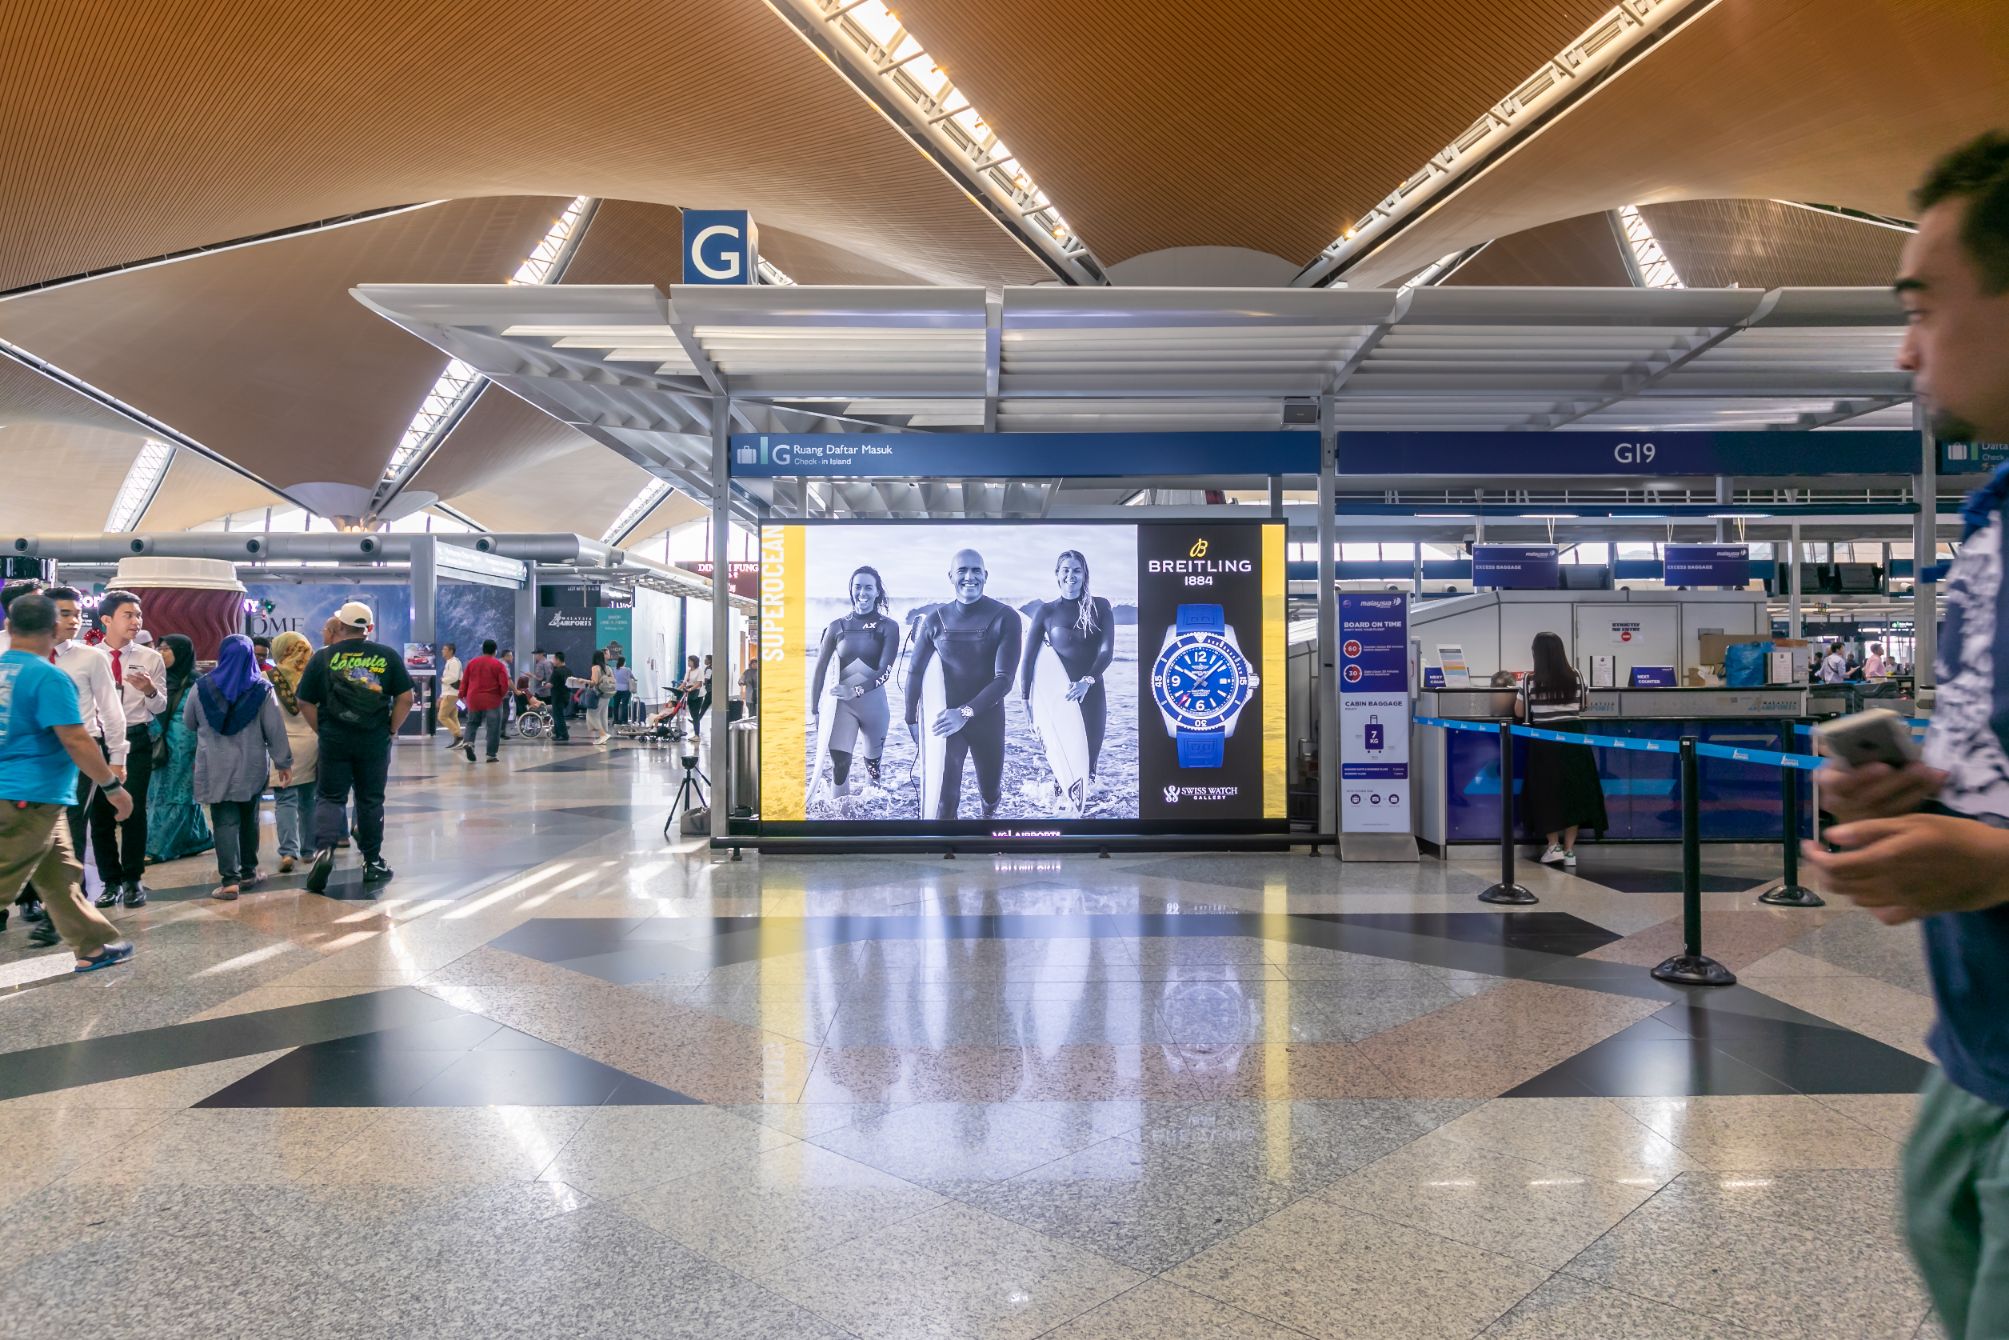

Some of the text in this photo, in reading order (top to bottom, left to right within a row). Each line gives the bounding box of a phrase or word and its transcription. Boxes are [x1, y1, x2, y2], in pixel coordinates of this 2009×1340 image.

[691, 225, 740, 279] G
[772, 444, 791, 465] G
[793, 445, 892, 456] Ruang Daftar Masuk
[1614, 443, 1656, 463] G19
[733, 563, 759, 572] FUNG
[1148, 560, 1252, 572] BREITLING
[1184, 576, 1213, 586] 1884
[761, 526, 785, 662] SUPEROCEAN
[1194, 651, 1208, 663] 12
[1171, 675, 1182, 687] 9
[1195, 699, 1206, 712] 6
[1371, 730, 1378, 739] 7
[1181, 786, 1239, 795] SWISS WATCH
